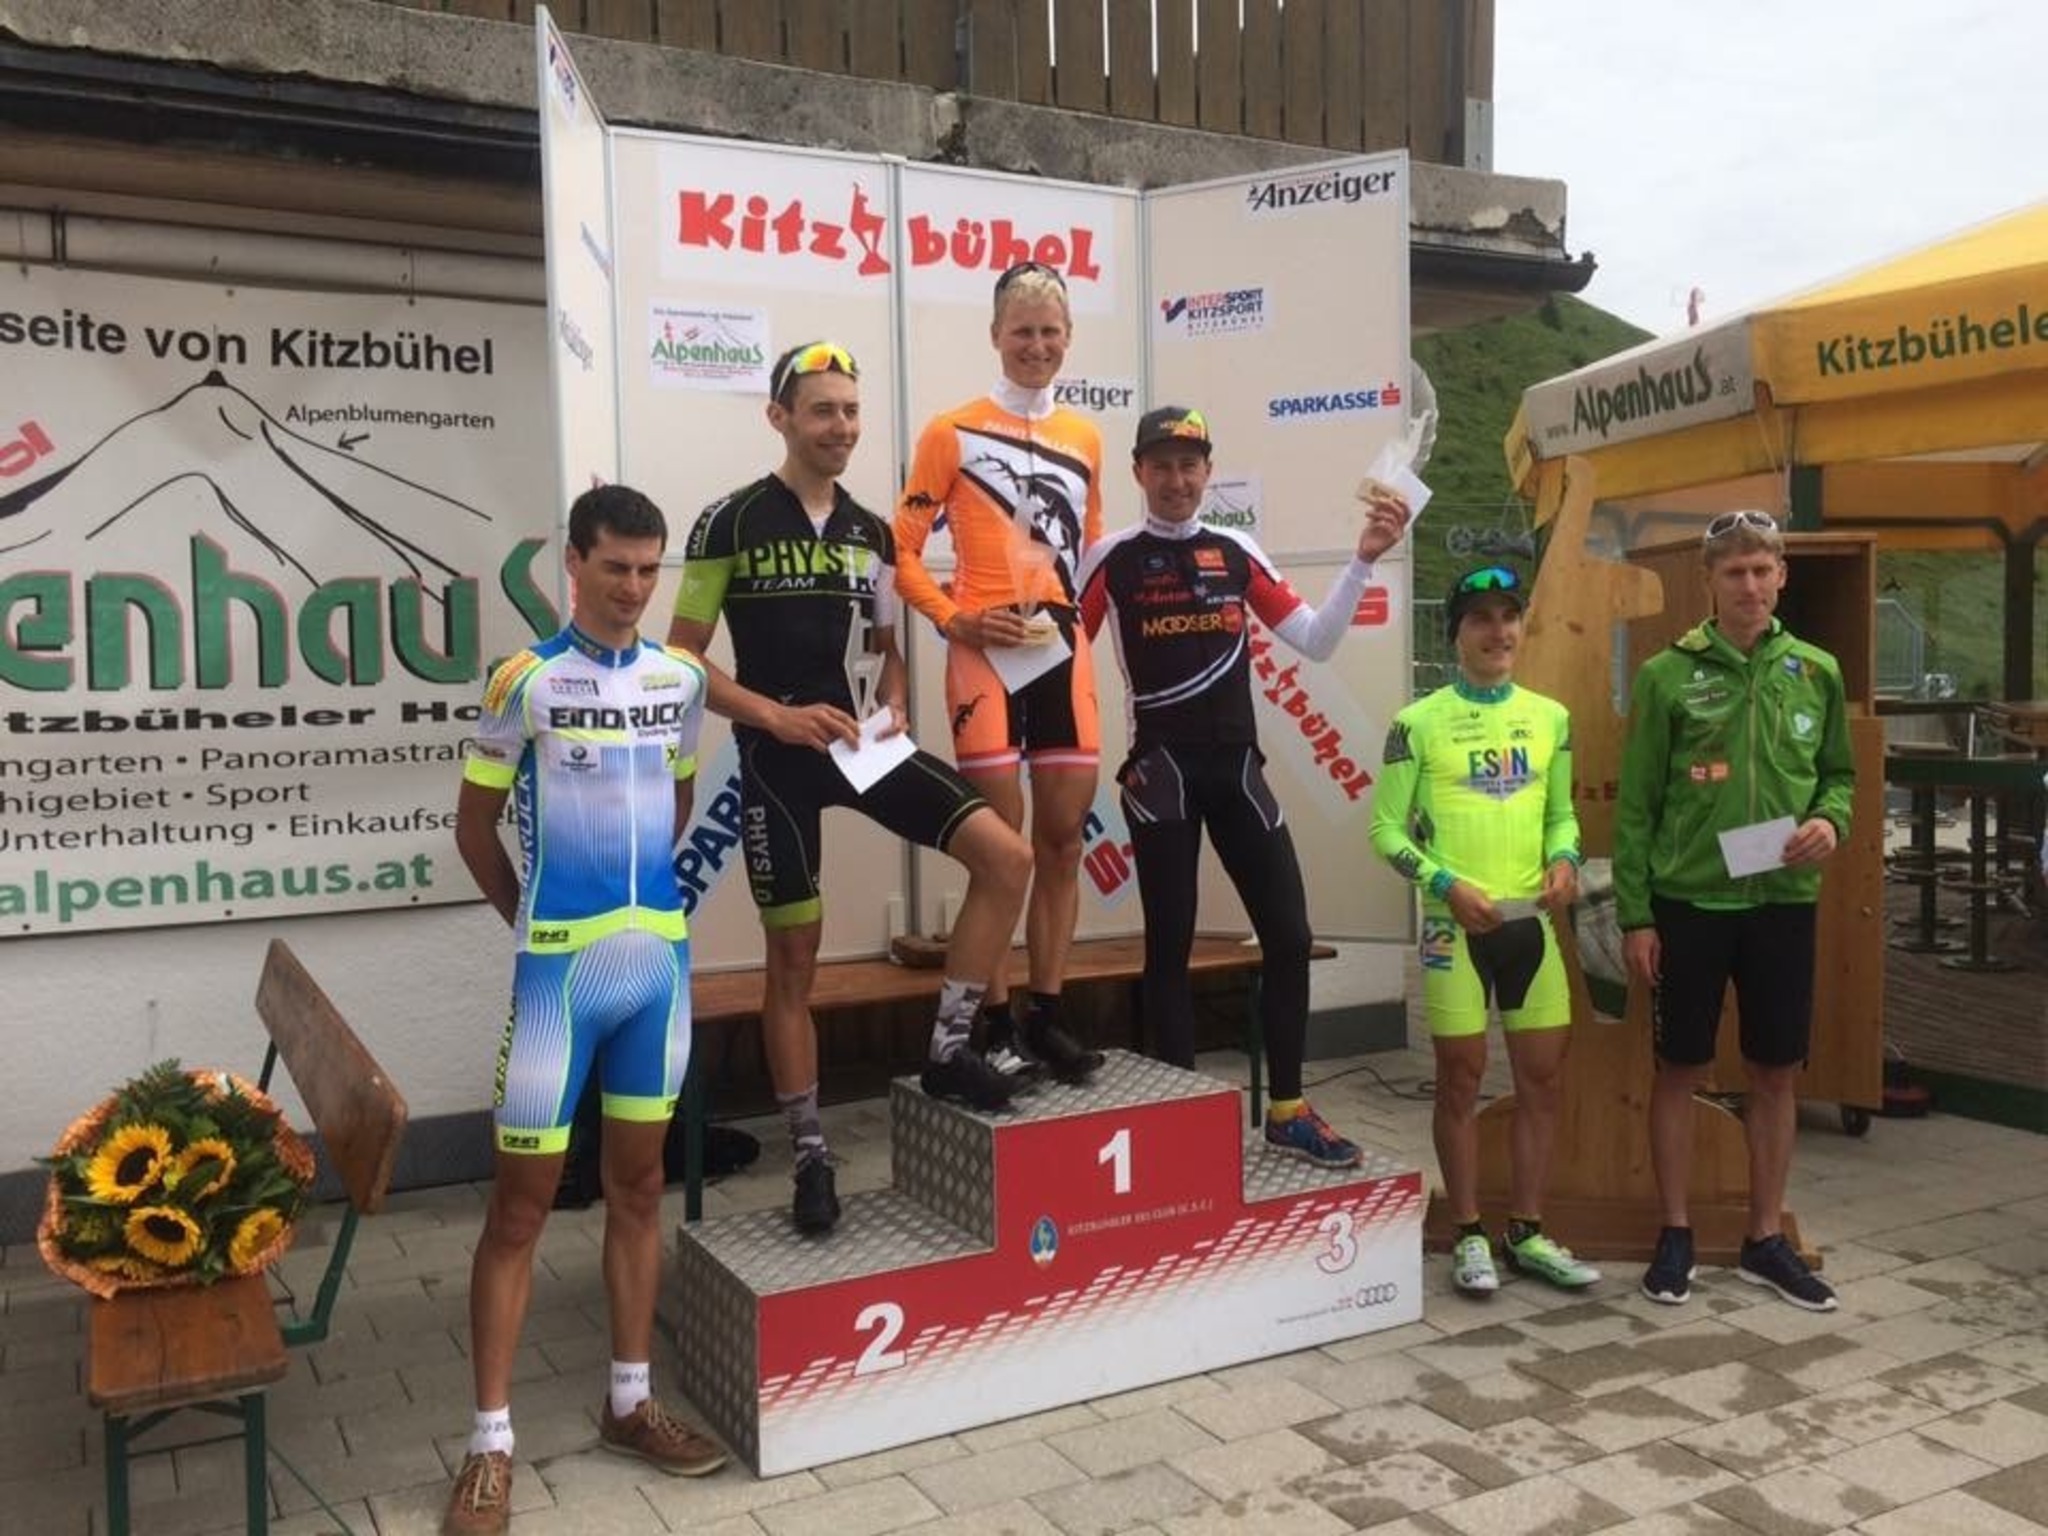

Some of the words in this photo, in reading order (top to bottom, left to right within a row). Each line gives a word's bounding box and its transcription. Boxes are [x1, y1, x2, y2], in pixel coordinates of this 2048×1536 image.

[1253, 171, 1396, 211] Anzeiger
[1187, 300, 1263, 320] KITZSPORT
[0, 308, 127, 355] seite
[145, 327, 248, 365] von
[270, 328, 495, 375] Kitzbühel
[285, 403, 496, 430] Alpenblumengarten
[1268, 389, 1379, 418] SPARKASSE
[2, 706, 377, 734] tzbüheler
[1468, 746, 1529, 779] ESIN
[206, 782, 311, 810] Sport
[0, 853, 434, 924] alpenhaus.at
[1098, 1129, 1133, 1195] 1
[1315, 1210, 1358, 1275] 3
[853, 1301, 907, 1378] 2
